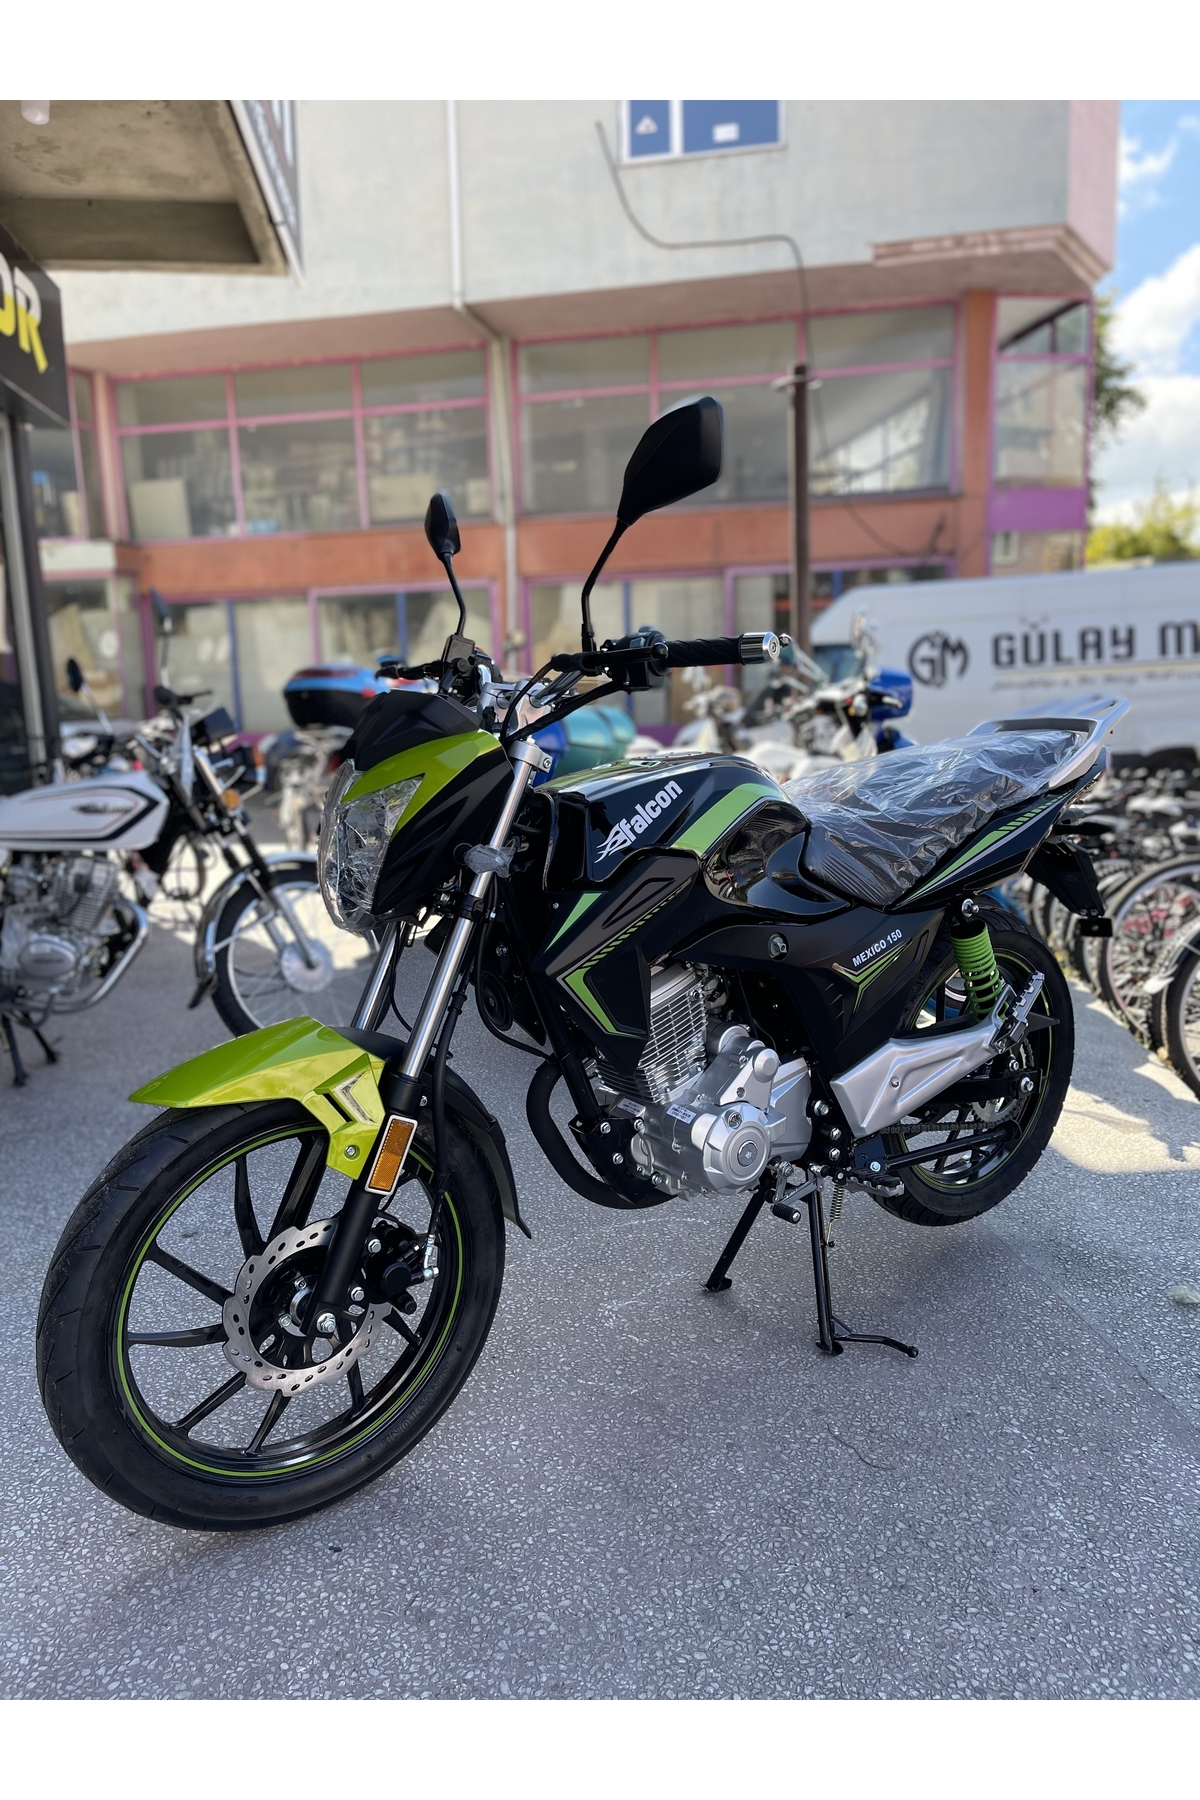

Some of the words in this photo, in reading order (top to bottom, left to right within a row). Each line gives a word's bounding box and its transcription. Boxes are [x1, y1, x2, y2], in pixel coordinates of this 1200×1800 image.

[619, 780, 683, 842] falcon
[852, 939, 887, 967] MEXICO
[886, 929, 902, 944] 150
